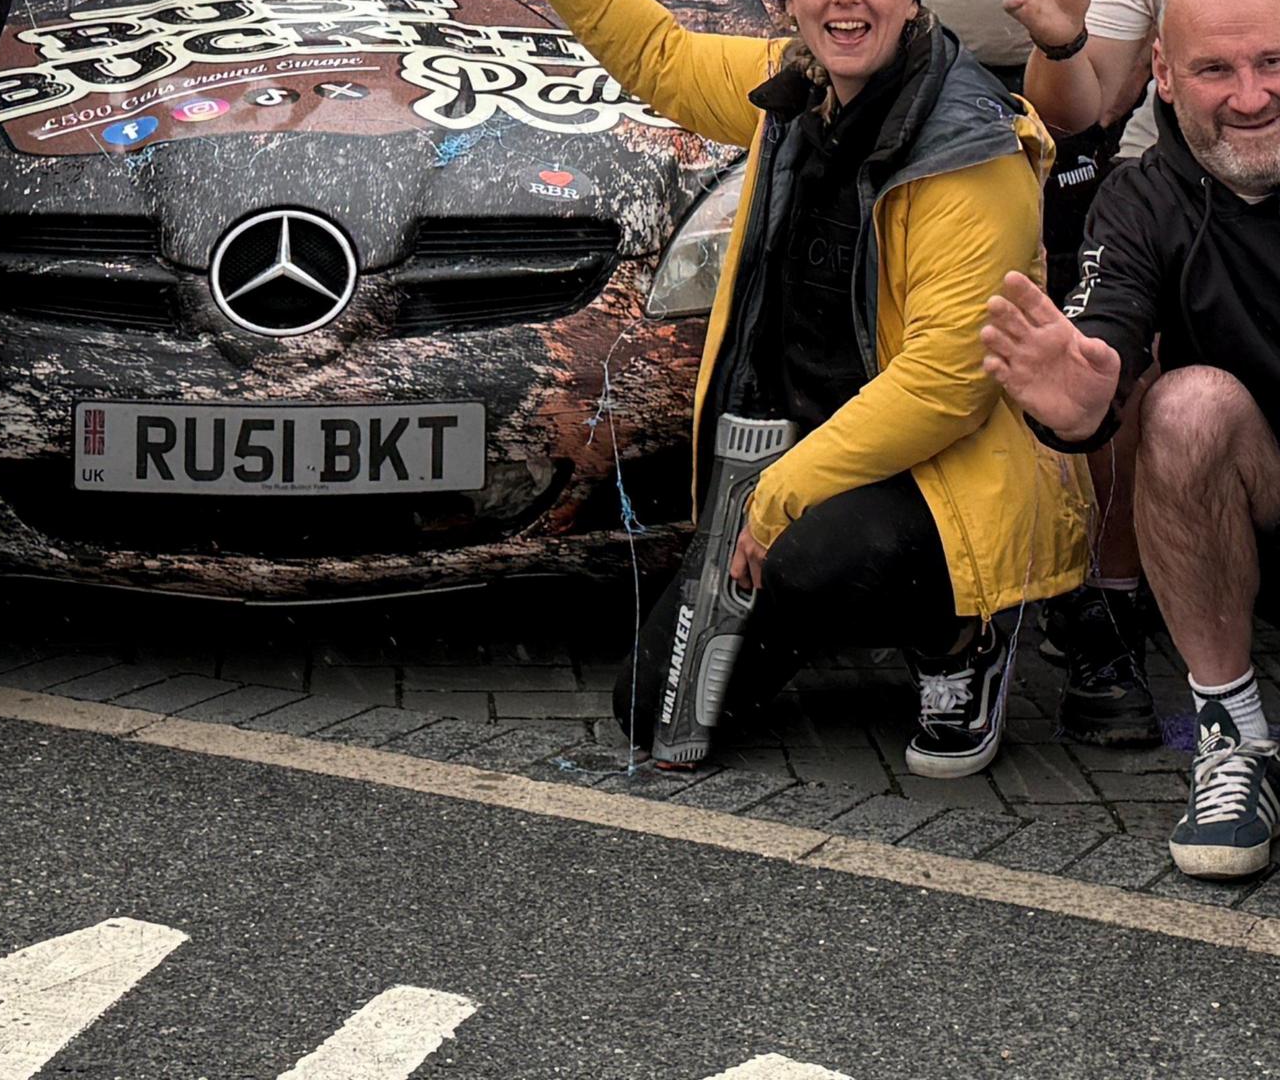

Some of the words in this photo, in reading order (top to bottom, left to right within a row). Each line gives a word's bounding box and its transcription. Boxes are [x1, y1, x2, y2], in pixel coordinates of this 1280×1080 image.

[183, 64, 268, 88] around
[276, 56, 364, 71] Europe
[1058, 164, 1096, 188] PUMA
[528, 182, 583, 199] RBR
[320, 415, 459, 482] BKT
[82, 467, 105, 483] UK
